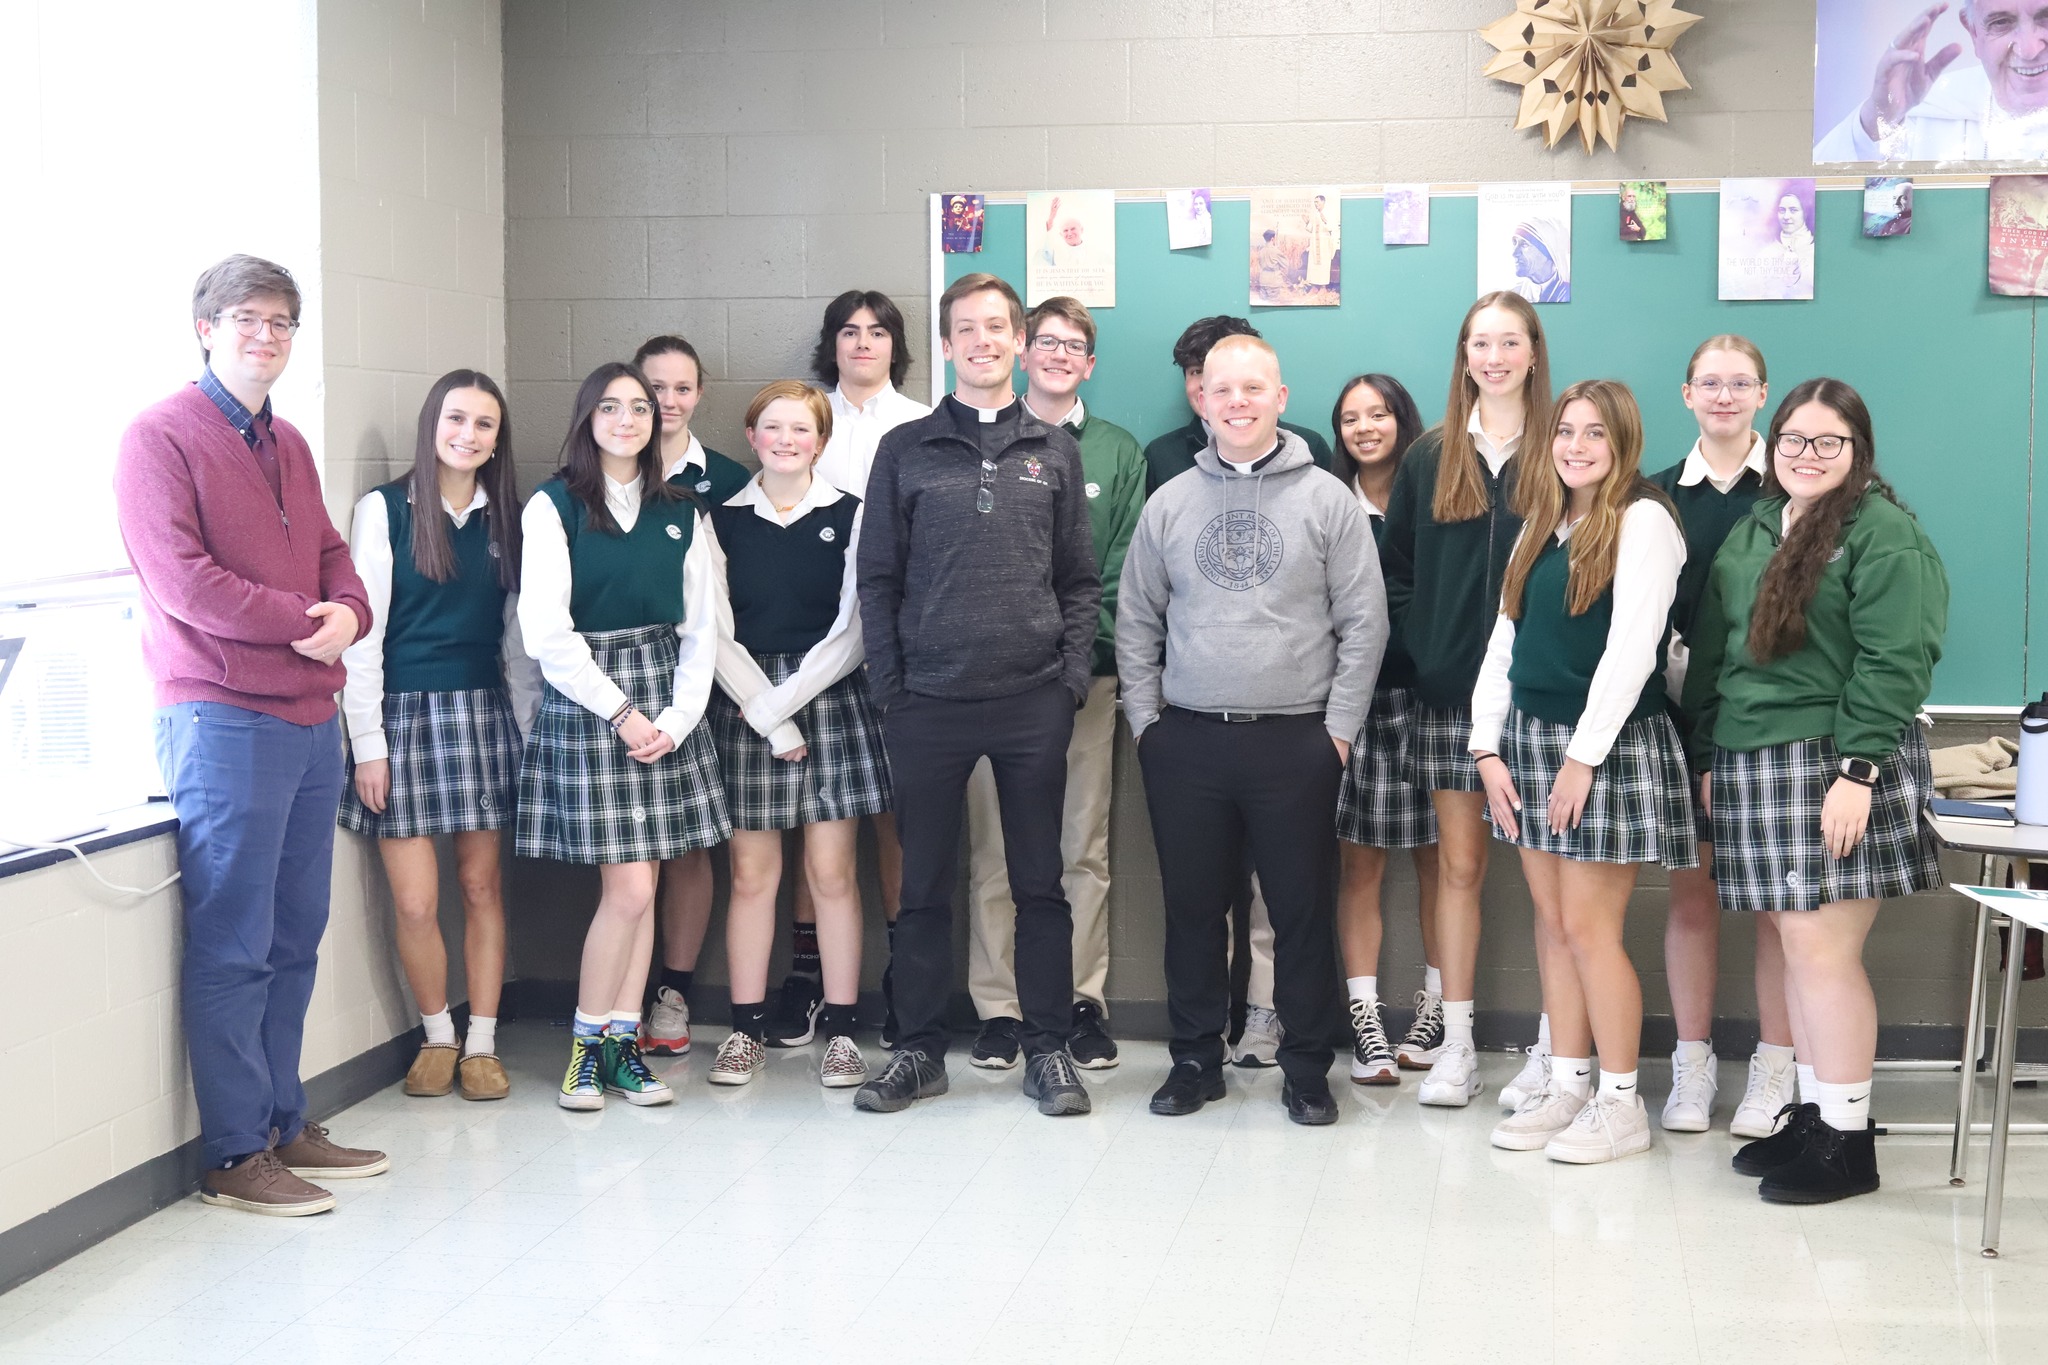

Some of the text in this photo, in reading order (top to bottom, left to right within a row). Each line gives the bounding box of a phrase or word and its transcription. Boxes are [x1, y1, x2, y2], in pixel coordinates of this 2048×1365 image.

[1739, 257, 1762, 266] WORLD
[1216, 512, 1246, 524] SINT
[1246, 514, 1271, 528] MRY
[1207, 523, 1217, 534] OF
[1268, 528, 1278, 538] OF
[1198, 536, 1220, 581] UNIVERSITY
[1259, 560, 1277, 580] LAKE
[1229, 581, 1249, 589] 1844
